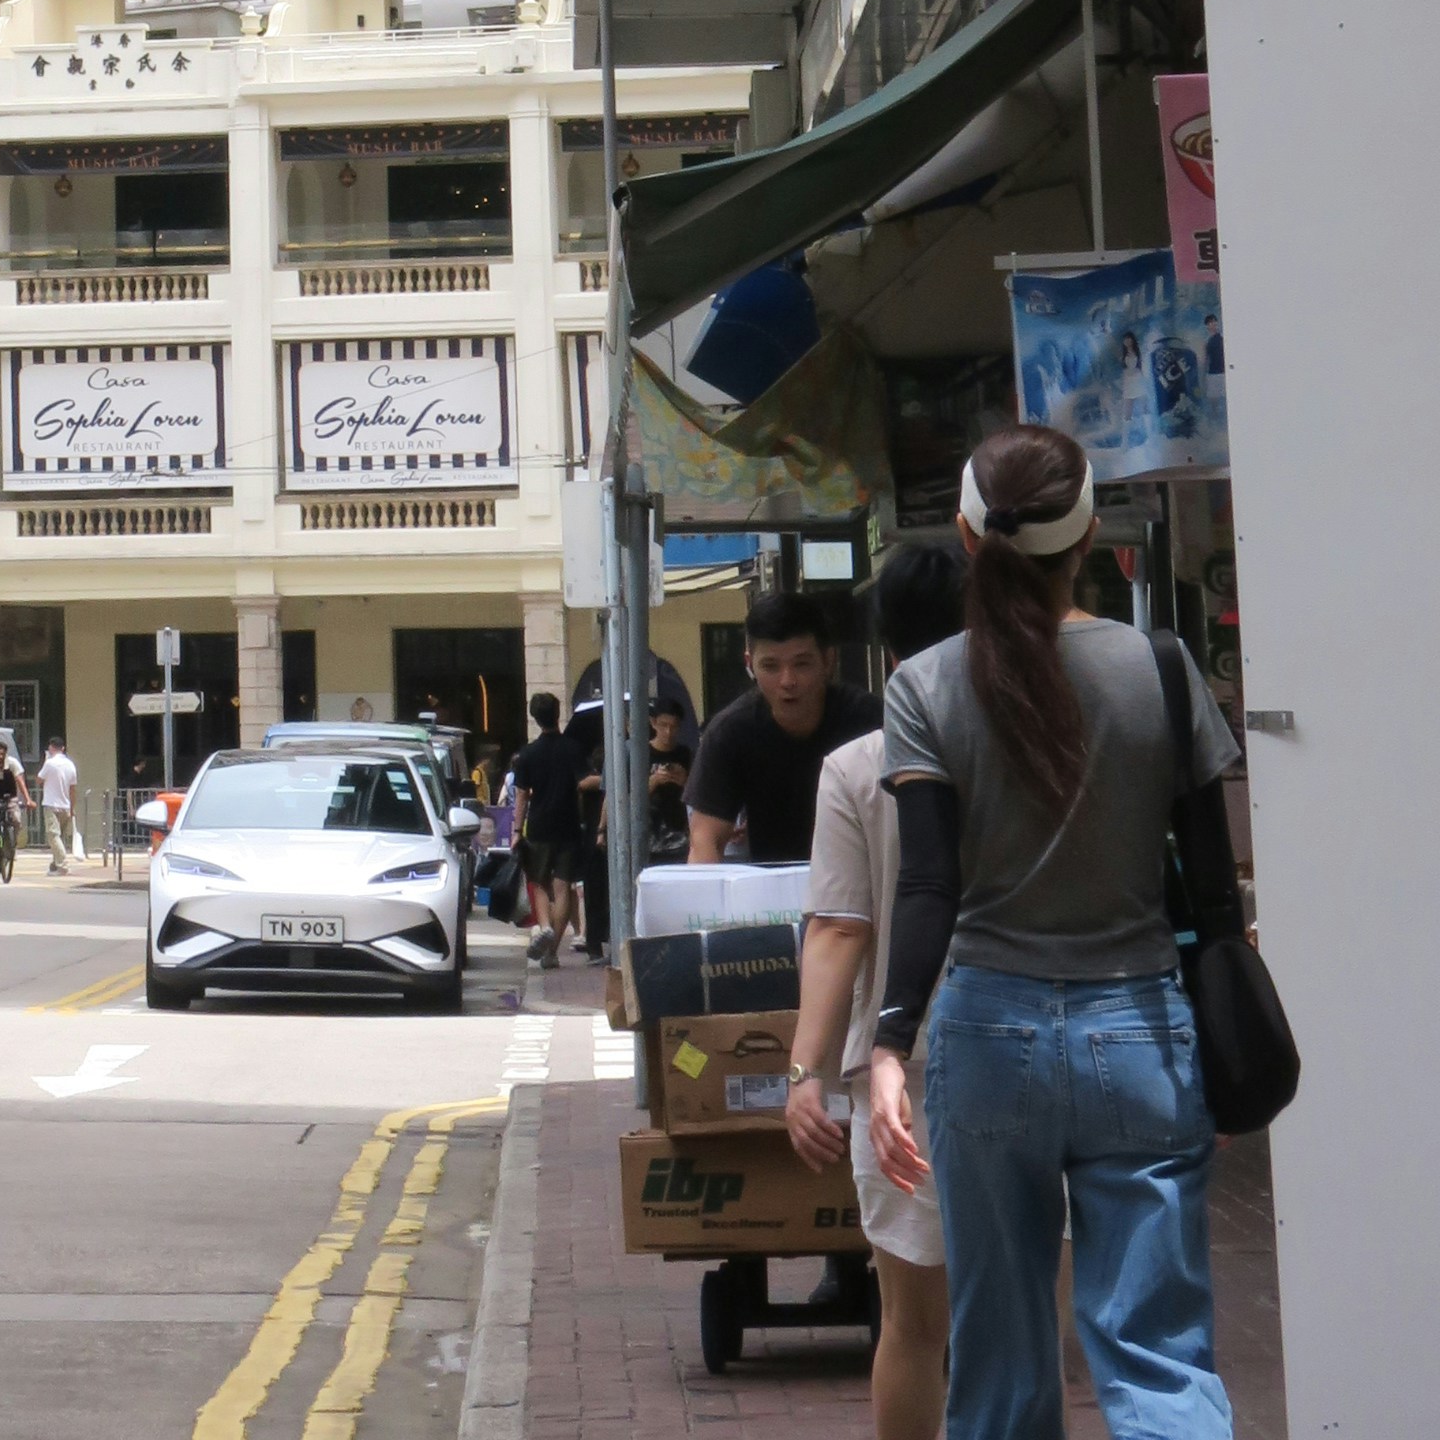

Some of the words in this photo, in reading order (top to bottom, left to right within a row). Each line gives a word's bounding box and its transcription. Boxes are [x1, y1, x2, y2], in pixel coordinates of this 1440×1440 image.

[629, 132, 684, 145] MUSIC
[693, 129, 728, 142] BAR
[347, 142, 401, 155] MUSIC
[410, 140, 444, 153] BAR
[67, 157, 118, 169] MUSIC
[128, 156, 161, 168] BAR
[87, 367, 149, 391] Casa
[367, 364, 432, 389] Casa
[33, 397, 128, 447] Sophia
[124, 400, 203, 440] Loren
[313, 395, 410, 446] Sophia
[405, 398, 486, 439] Loren
[73, 440, 162, 453] RESTAURANT
[353, 439, 445, 451] RESTAURANT
[269, 920, 292, 936] TN
[300, 921, 337, 937] 903
[641, 1158, 745, 1214] ibp
[642, 1207, 700, 1219] Trusted
